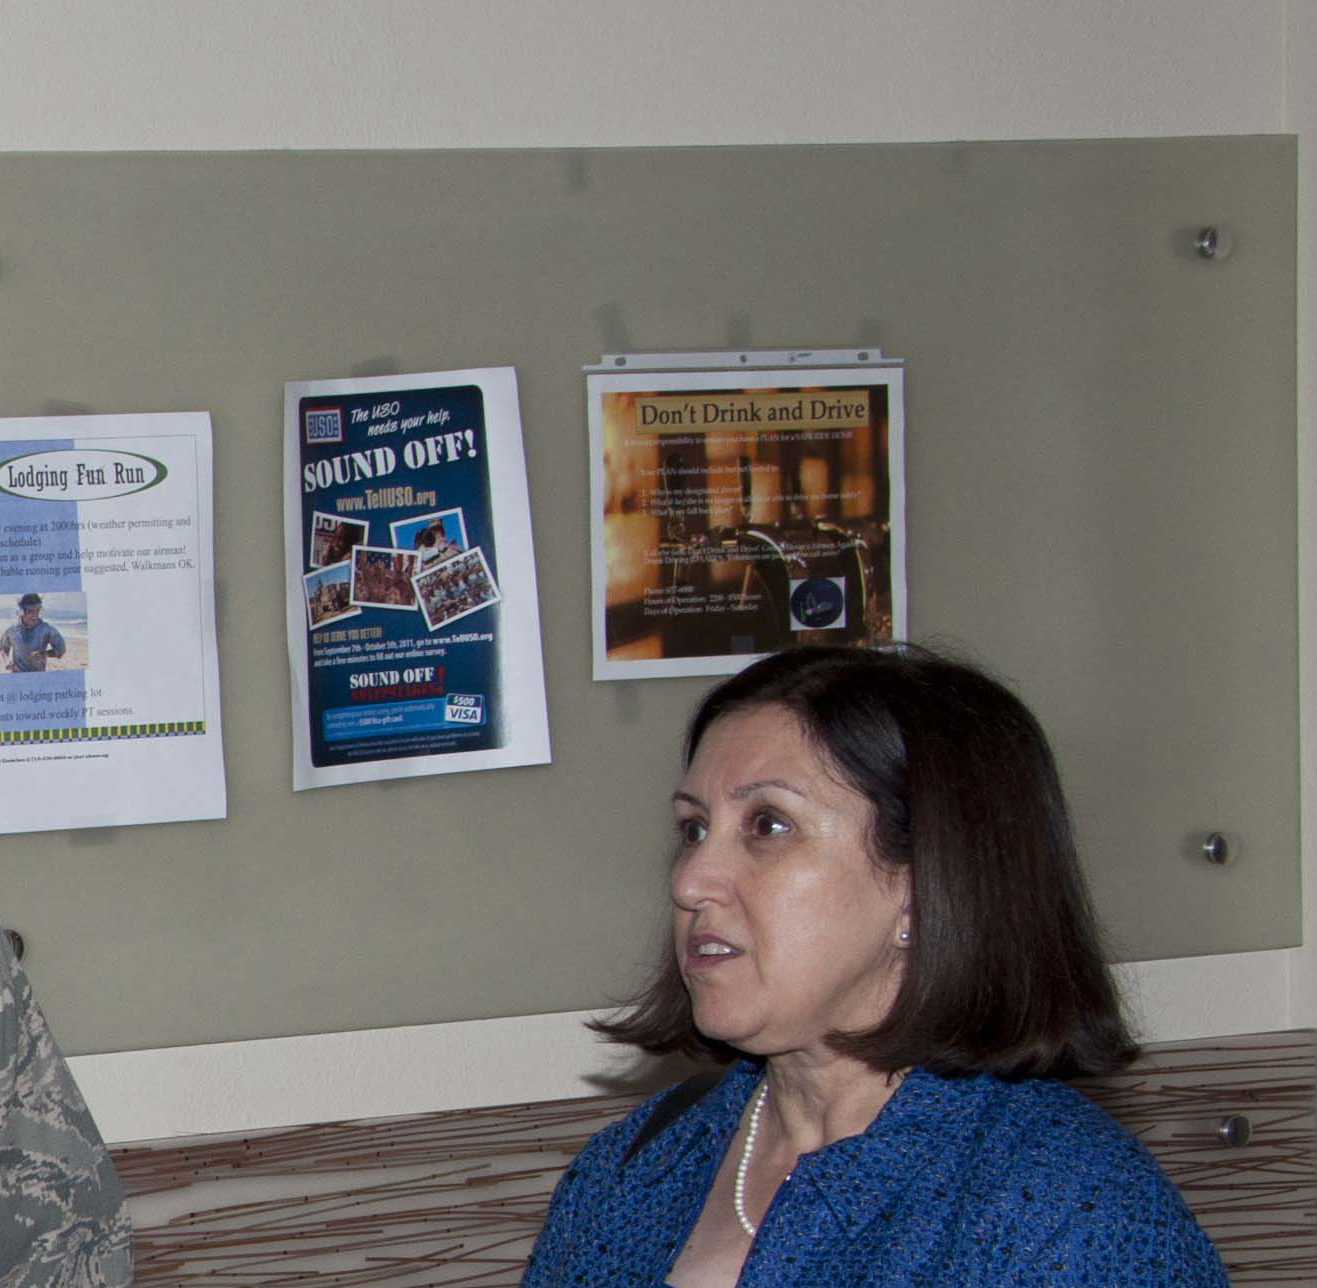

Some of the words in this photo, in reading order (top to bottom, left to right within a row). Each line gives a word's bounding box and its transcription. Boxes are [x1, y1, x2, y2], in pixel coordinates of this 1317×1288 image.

[350, 409, 369, 424] The
[371, 401, 400, 419] USO
[641, 403, 697, 425] Don't
[703, 401, 762, 424] Drink
[767, 401, 803, 421] and
[811, 399, 865, 420] Drive
[312, 415, 336, 437] USO
[367, 421, 398, 437] needs
[401, 415, 425, 434] your
[426, 408, 451, 426] help.
[303, 447, 396, 493] SOUND
[404, 428, 478, 470] OFF!
[7, 463, 68, 491] Lodging
[77, 462, 106, 486] Fun
[115, 461, 145, 485] Run
[336, 486, 437, 512] www.TellUSO.org
[88, 518, 126, 530] (weather
[128, 516, 173, 529] permitting
[175, 514, 191, 526] and
[10, 554, 19, 562] as
[29, 552, 55, 564] group
[57, 549, 73, 560] and
[75, 547, 94, 560] help
[96, 546, 134, 557] motivate
[136, 548, 151, 556] our
[349, 671, 400, 689] SOUND
[19, 690, 53, 703] lodging
[54, 688, 87, 702] parking
[90, 687, 102, 697] lot
[453, 695, 475, 706] $500
[16, 709, 46, 721] toward
[49, 708, 79, 720] weekly
[82, 706, 95, 718] PT
[449, 707, 478, 721] VISA
